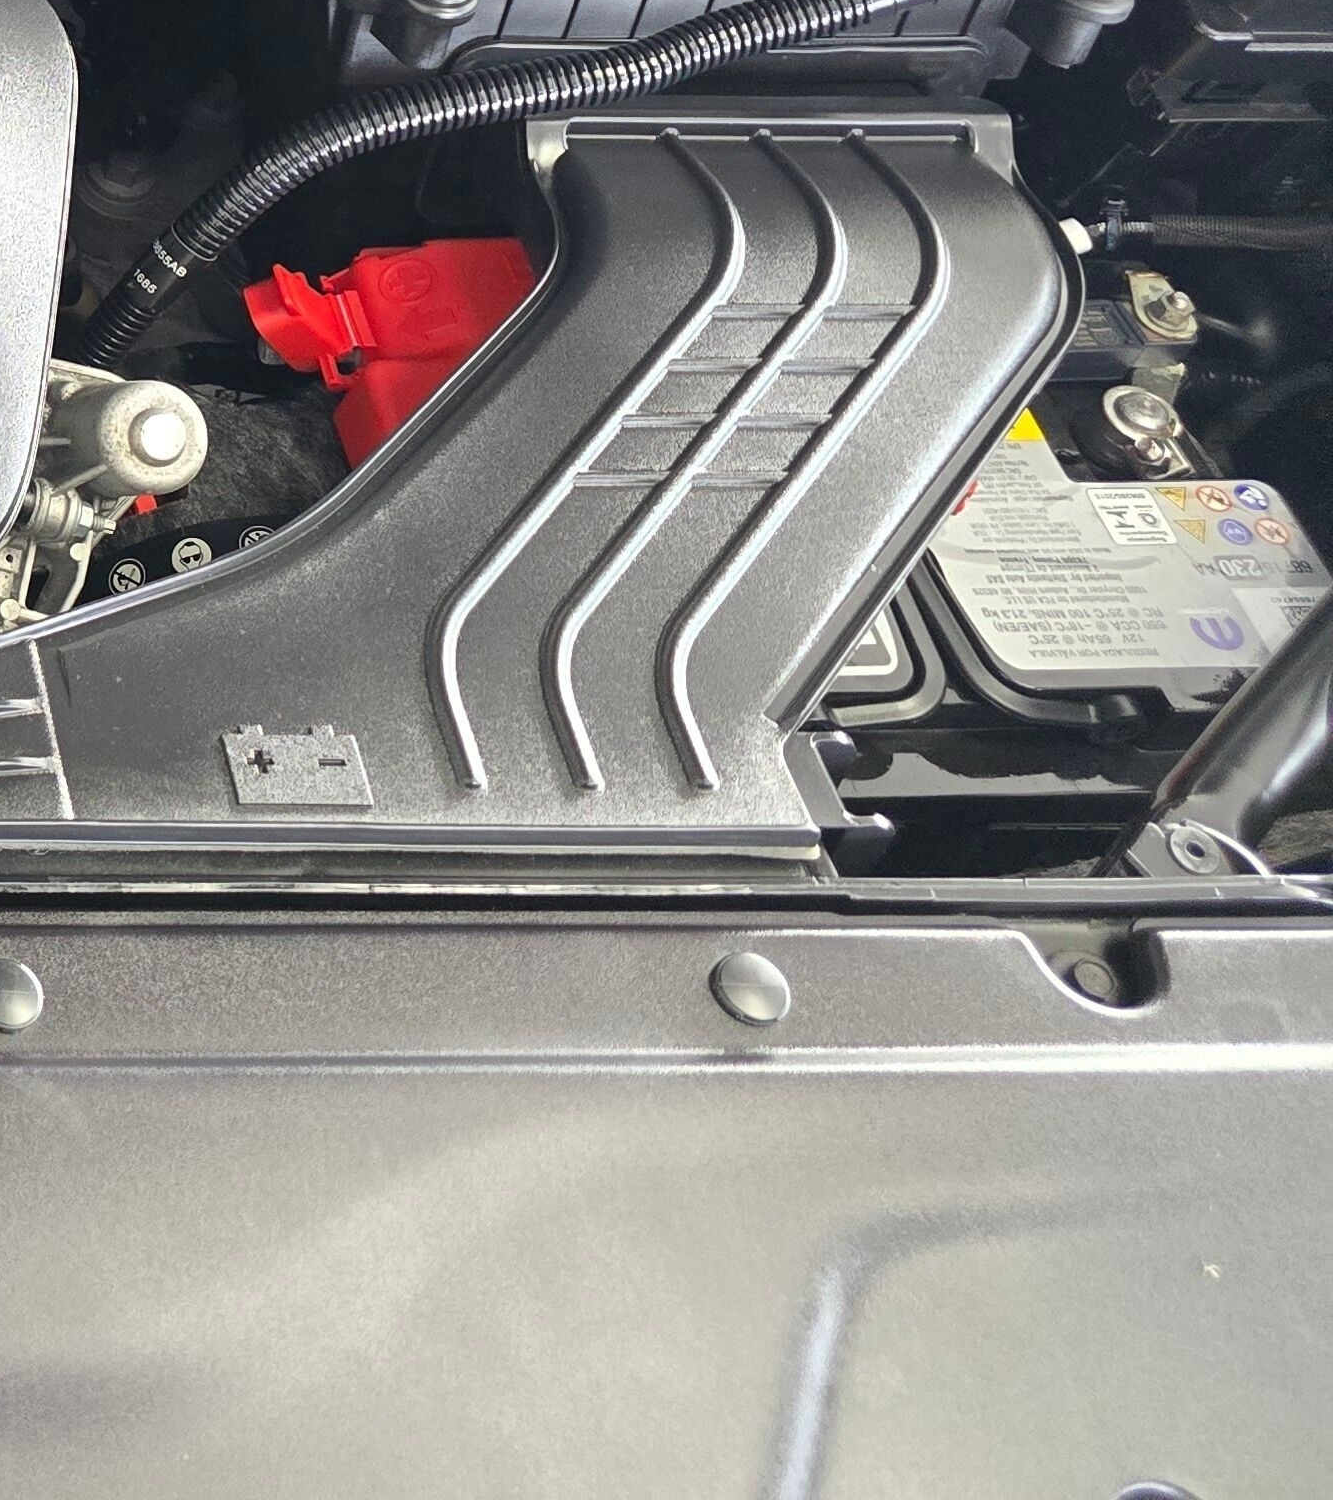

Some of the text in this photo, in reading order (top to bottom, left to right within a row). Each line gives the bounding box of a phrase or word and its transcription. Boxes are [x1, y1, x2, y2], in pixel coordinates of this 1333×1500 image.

[981, 607, 999, 619] kg
[1069, 608, 1090, 618] 100
[1141, 606, 1163, 616] RC
[992, 620, 1052, 632] (SAE/EN)
[1110, 620, 1139, 631] CCA
[1142, 619, 1166, 630] 650
[1076, 633, 1111, 644] 65Ah
[1122, 633, 1144, 643] 12V
